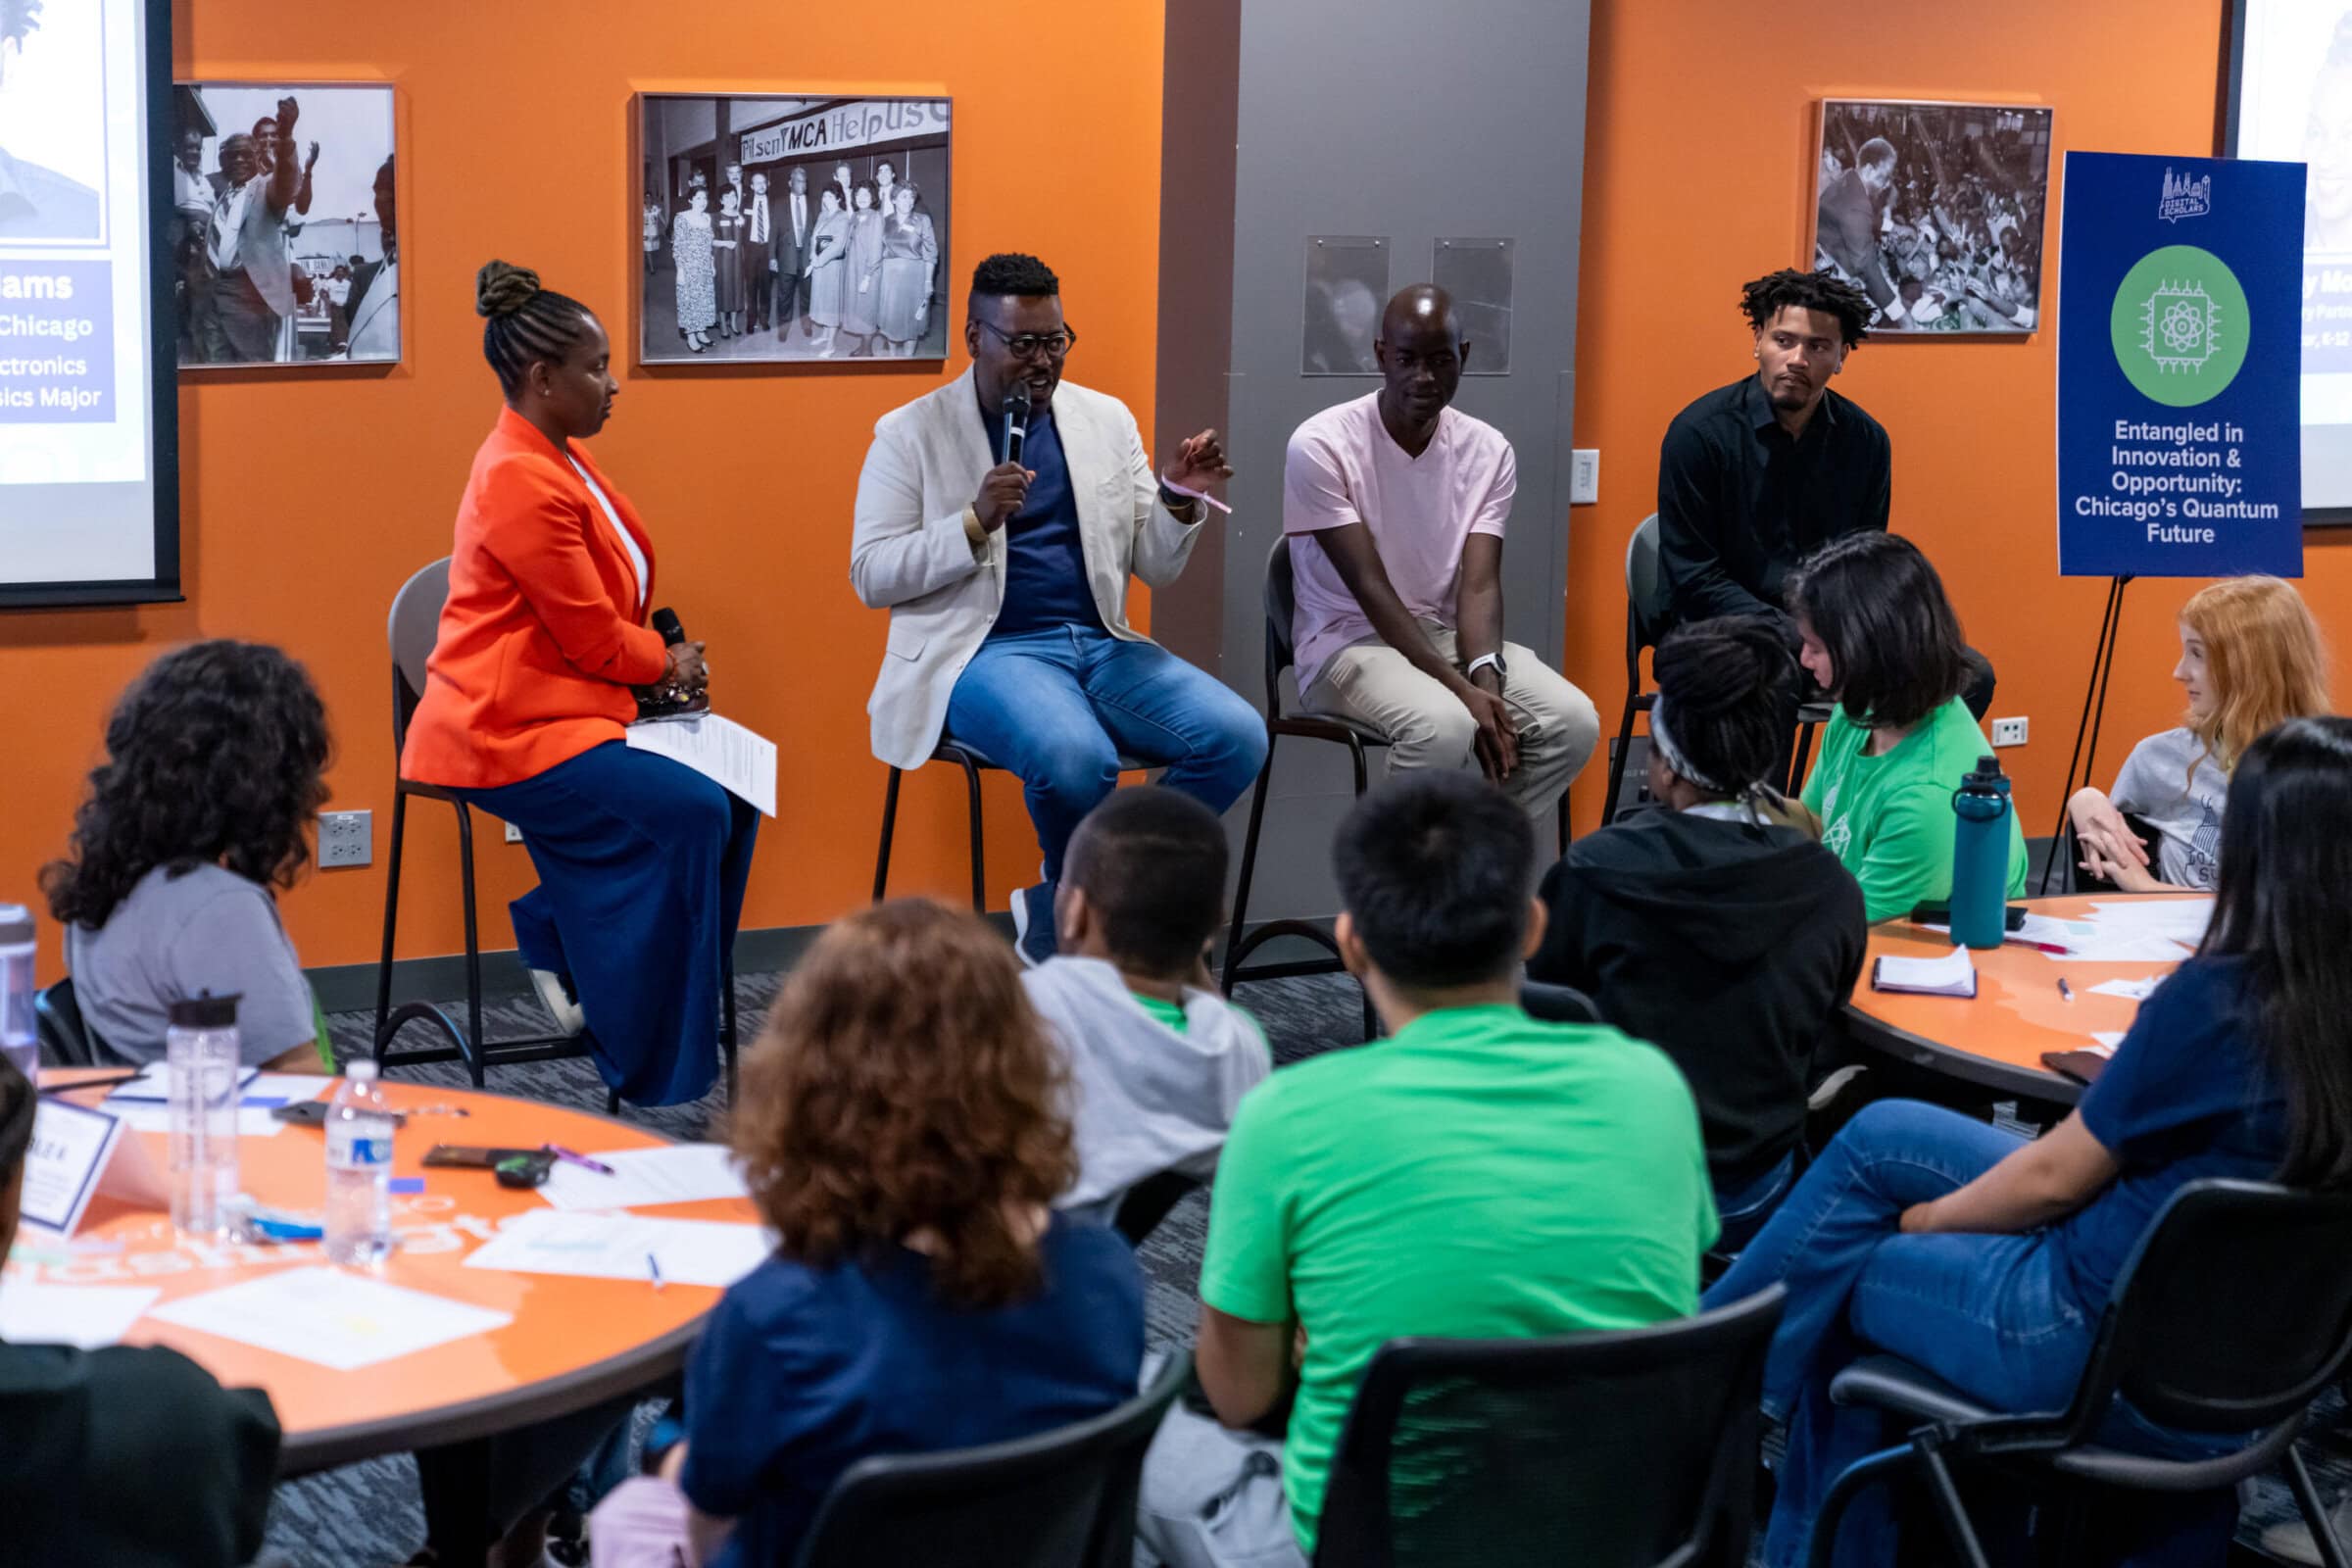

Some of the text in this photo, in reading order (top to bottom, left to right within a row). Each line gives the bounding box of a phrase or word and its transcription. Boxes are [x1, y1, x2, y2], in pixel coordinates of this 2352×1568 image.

[780, 119, 827, 151] YMCA
[2164, 204, 2203, 215] SCHOLARS
[0, 274, 74, 300] ams
[0, 314, 93, 342] Chicago
[39, 386, 102, 413] Major
[2115, 419, 2243, 446] Entangled in
[2112, 445, 2241, 468] Innovation &
[2112, 470, 2242, 498] Opportunity:
[2075, 496, 2278, 521] Chicago's Quantum
[2147, 522, 2215, 544] Future
